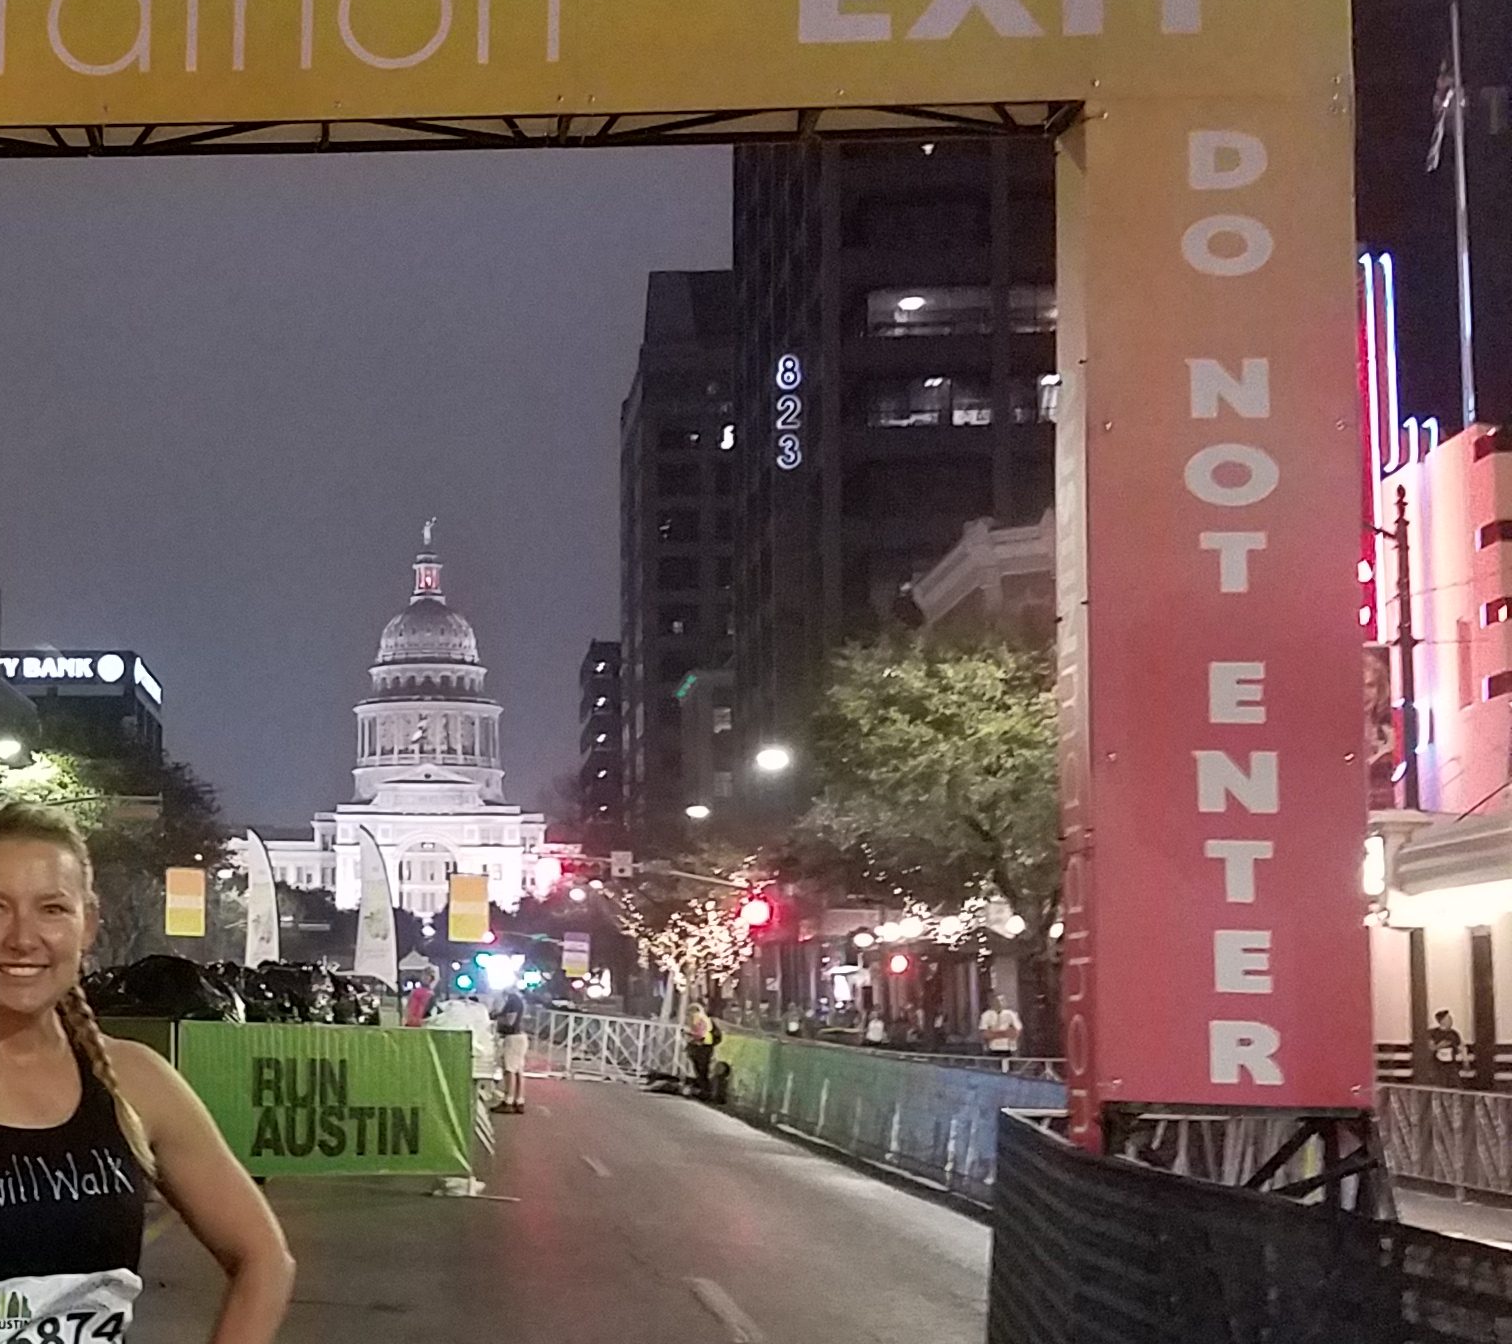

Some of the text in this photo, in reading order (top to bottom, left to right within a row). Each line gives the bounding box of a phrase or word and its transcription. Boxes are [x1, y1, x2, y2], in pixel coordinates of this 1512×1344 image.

[775, 354, 802, 470] 823
[1181, 129, 1285, 1087] DO NOT ENTER
[22, 657, 94, 678] BANK
[253, 1057, 348, 1106] RUN
[250, 1106, 420, 1157] AUSTIN
